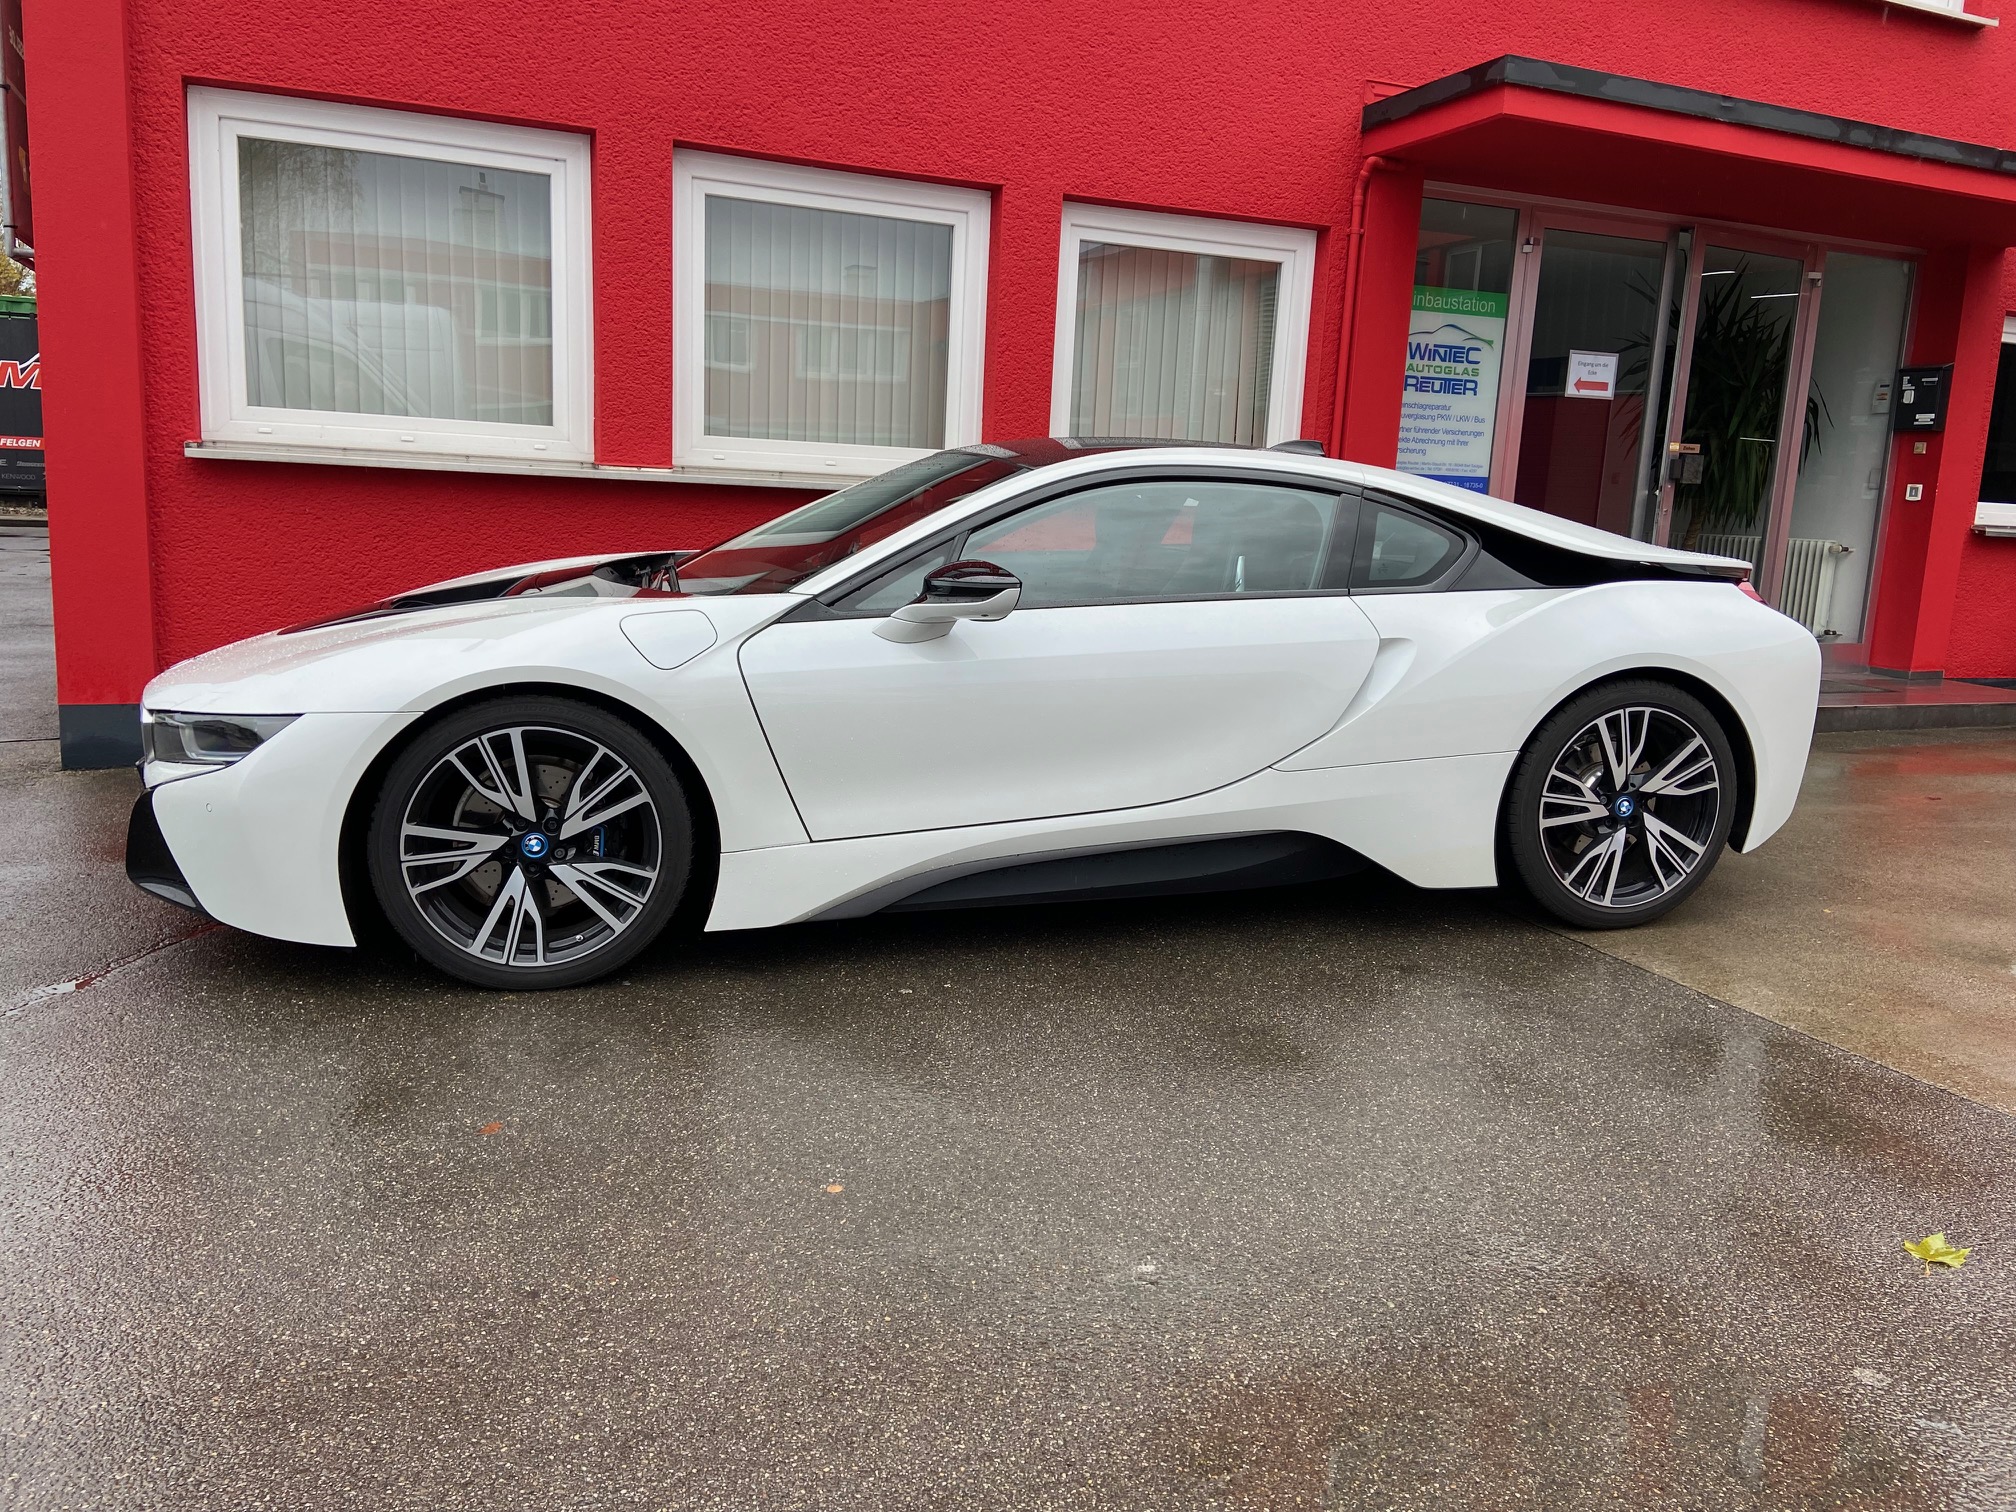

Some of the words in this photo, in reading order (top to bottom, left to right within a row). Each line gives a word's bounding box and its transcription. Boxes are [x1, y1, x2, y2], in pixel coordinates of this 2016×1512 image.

[1413, 291, 1496, 313] inbaustation
[1406, 362, 1480, 377] AUTOGLAS
[1403, 374, 1479, 396] REUTTER
[1436, 413, 1451, 422] PKW
[1455, 415, 1470, 423] LKW
[1474, 415, 1486, 424] Bus
[1413, 425, 1441, 435] führender
[1441, 427, 1485, 438] Versicherungen
[1411, 436, 1446, 447] Abrechnung
